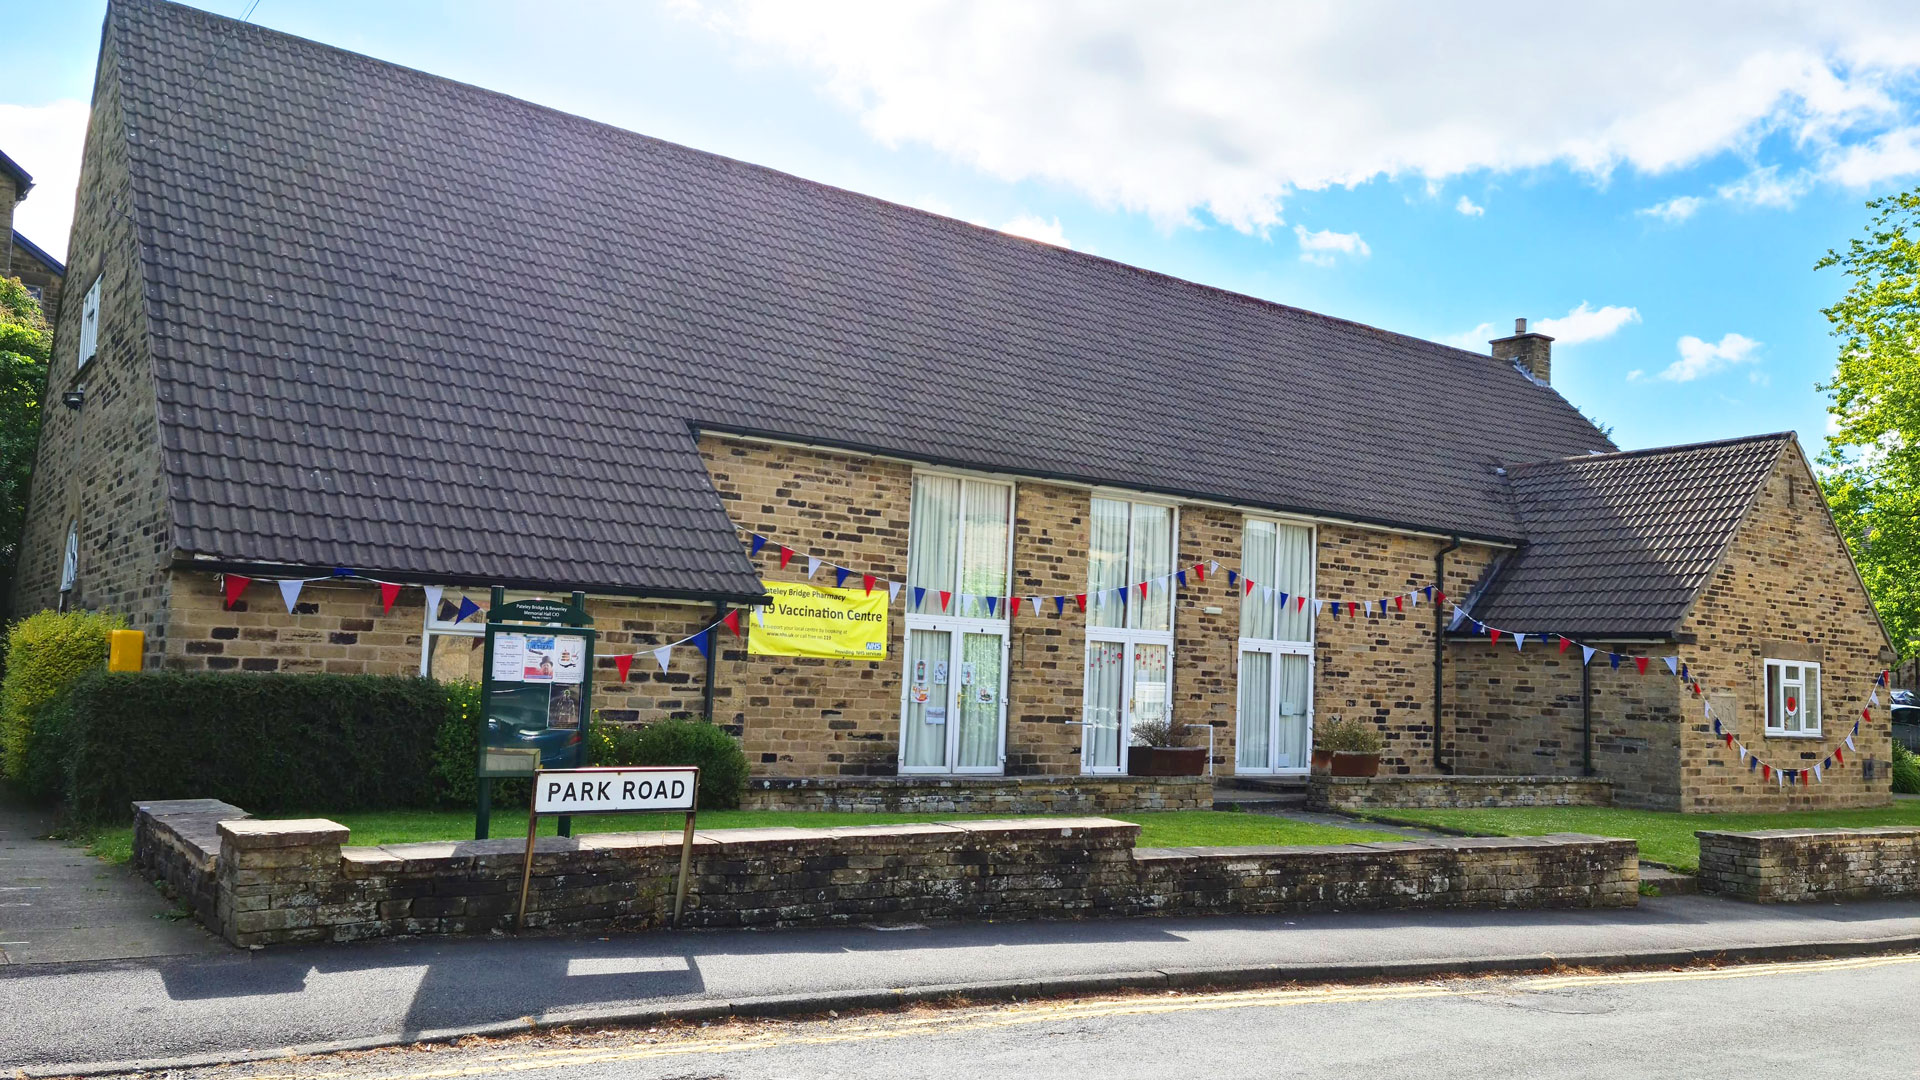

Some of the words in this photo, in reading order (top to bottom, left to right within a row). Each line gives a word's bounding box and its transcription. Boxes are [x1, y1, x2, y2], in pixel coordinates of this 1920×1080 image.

[766, 587, 787, 597] ateley
[788, 588, 810, 599] Bridge
[812, 590, 846, 602] Pharmacy
[779, 603, 844, 619] Vaccination
[847, 609, 882, 622] Centre
[866, 642, 882, 650] NHS
[547, 781, 611, 802] PARK
[622, 780, 685, 800] ROAD
